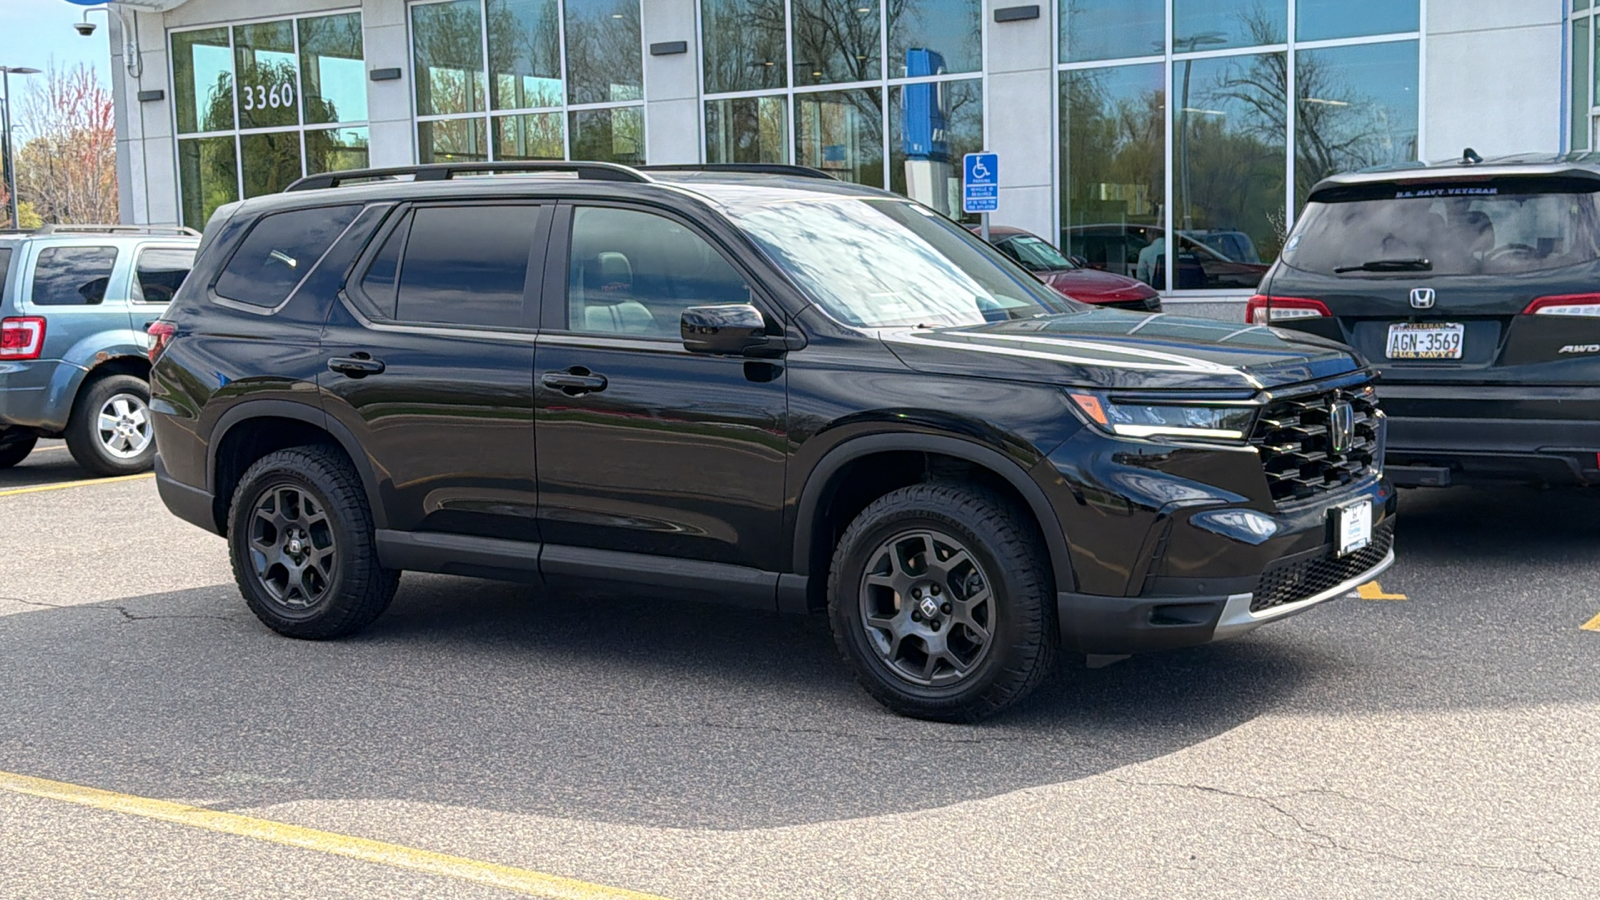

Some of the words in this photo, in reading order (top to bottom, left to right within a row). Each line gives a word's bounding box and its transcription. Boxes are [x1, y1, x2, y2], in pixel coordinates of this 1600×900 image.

[243, 82, 293, 111] 3360
[1416, 188, 1444, 196] NAVY
[1408, 322, 1446, 330] VETERAN
[1392, 333, 1461, 352] AGN-3569
[1558, 344, 1600, 354] AWD
